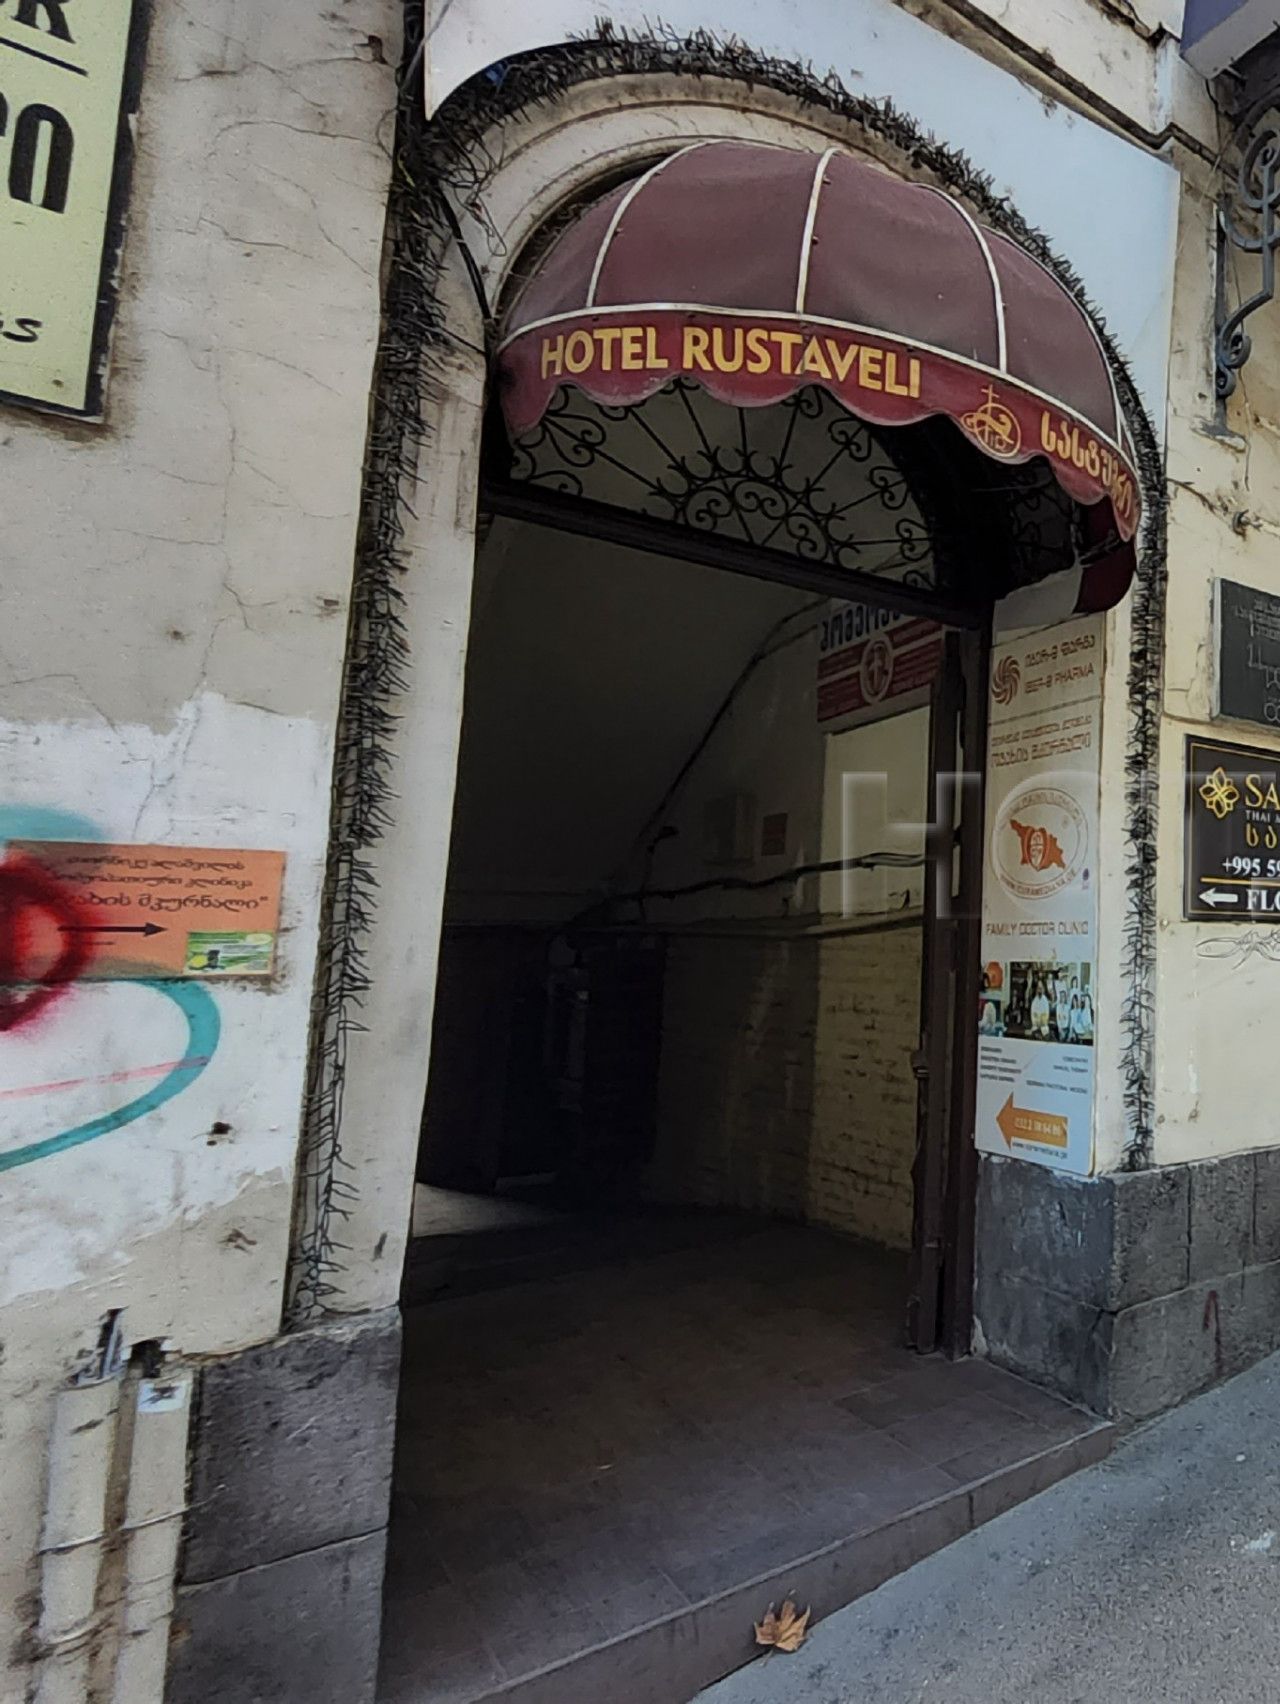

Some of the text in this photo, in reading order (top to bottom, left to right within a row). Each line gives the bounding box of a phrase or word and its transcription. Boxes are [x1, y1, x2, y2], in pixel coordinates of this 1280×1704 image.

[540, 326, 921, 399] HOTEL RUSTAVELI
[1245, 810, 1271, 823] THAI
[1222, 855, 1261, 877] +995
[986, 921, 1018, 936] FAMILY
